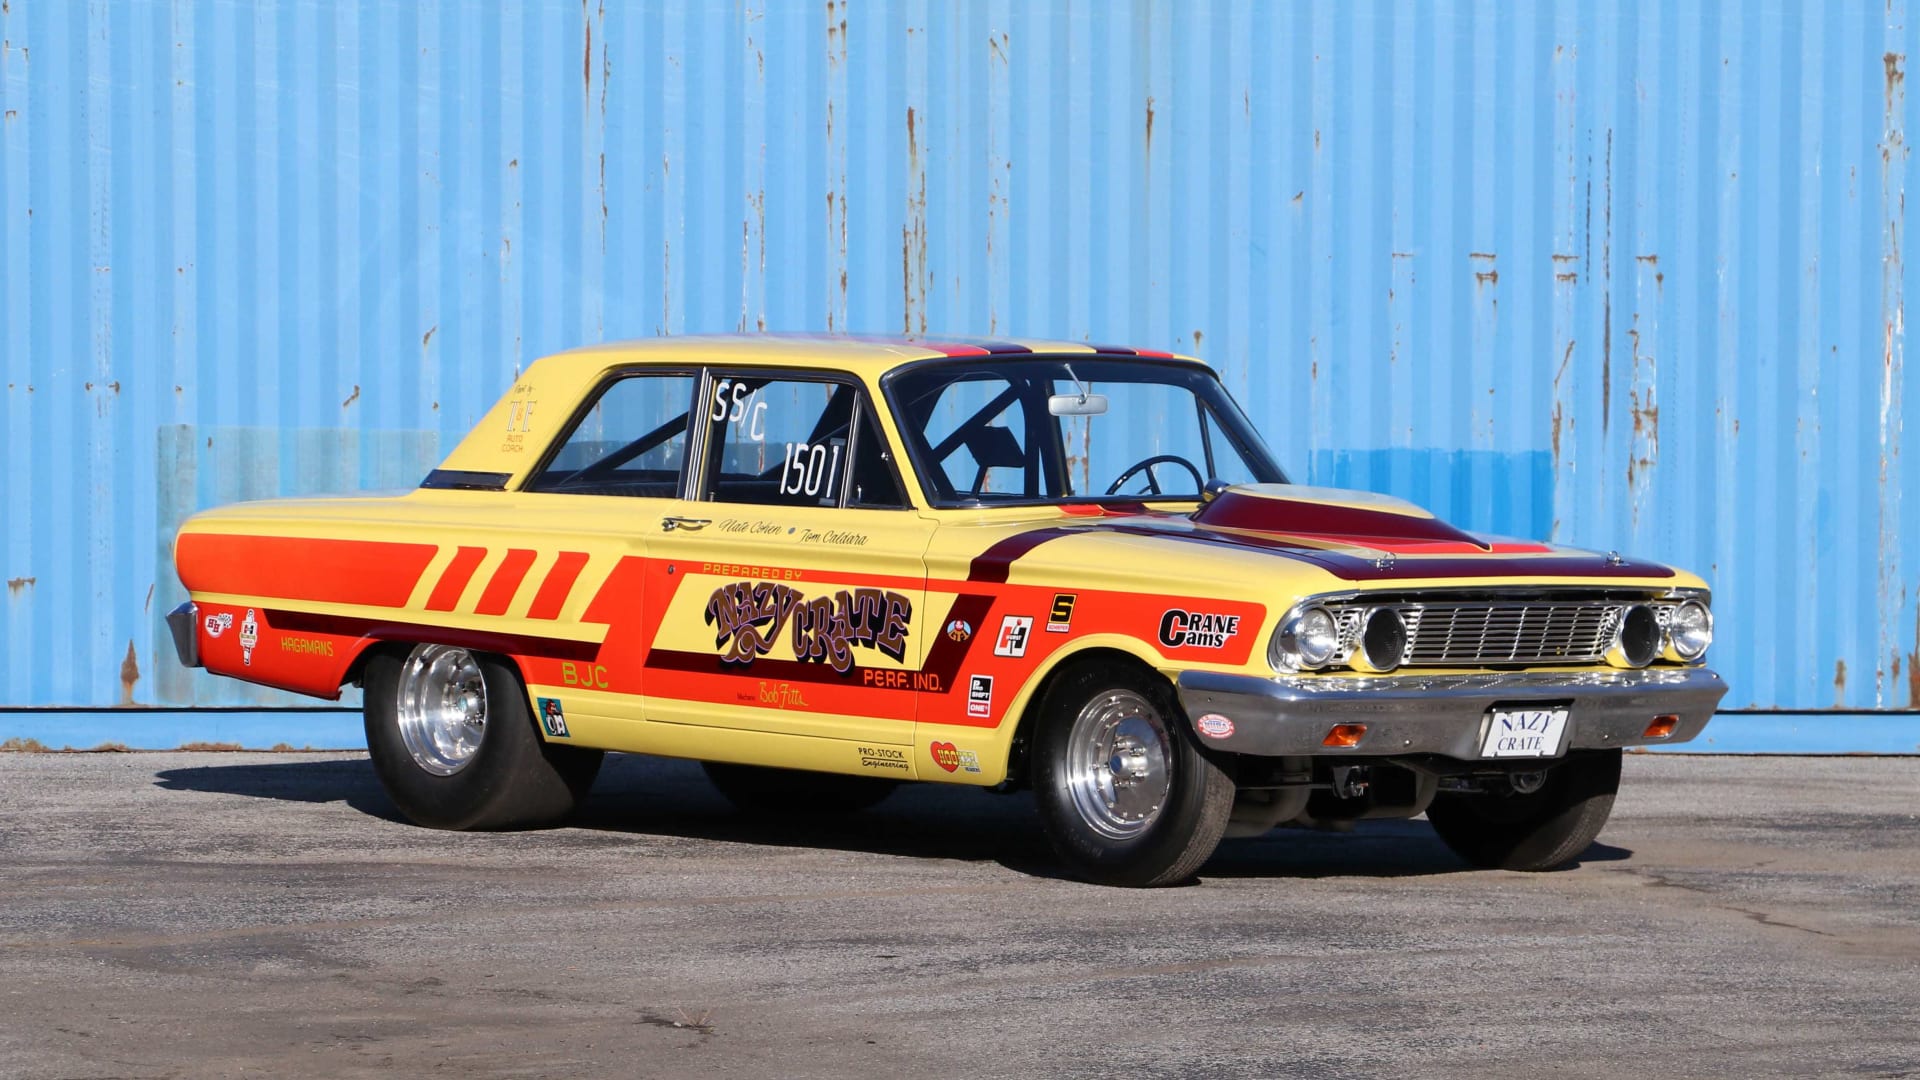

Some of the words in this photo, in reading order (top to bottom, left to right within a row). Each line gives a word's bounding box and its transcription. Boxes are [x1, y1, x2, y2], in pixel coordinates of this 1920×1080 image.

[712, 382, 768, 441] SS/C
[780, 442, 840, 498] 1501
[718, 519, 749, 533] Nate
[750, 520, 782, 536] Cohen
[800, 528, 821, 543] Tom
[822, 530, 869, 546] Caldara
[703, 562, 780, 580] PREPARED
[784, 569, 802, 581] BY
[703, 581, 804, 668] NAZY
[791, 587, 912, 678] CRATE
[281, 636, 334, 657] HAGAMANS
[562, 661, 608, 689] BJC
[864, 669, 909, 689] PERF.
[913, 671, 943, 692] IND.
[759, 681, 779, 703] Bob
[1501, 713, 1553, 737] NAZY
[858, 746, 905, 760] PRO-STOCK
[1498, 736, 1544, 751] CRATE
[862, 759, 909, 772] Engineering
